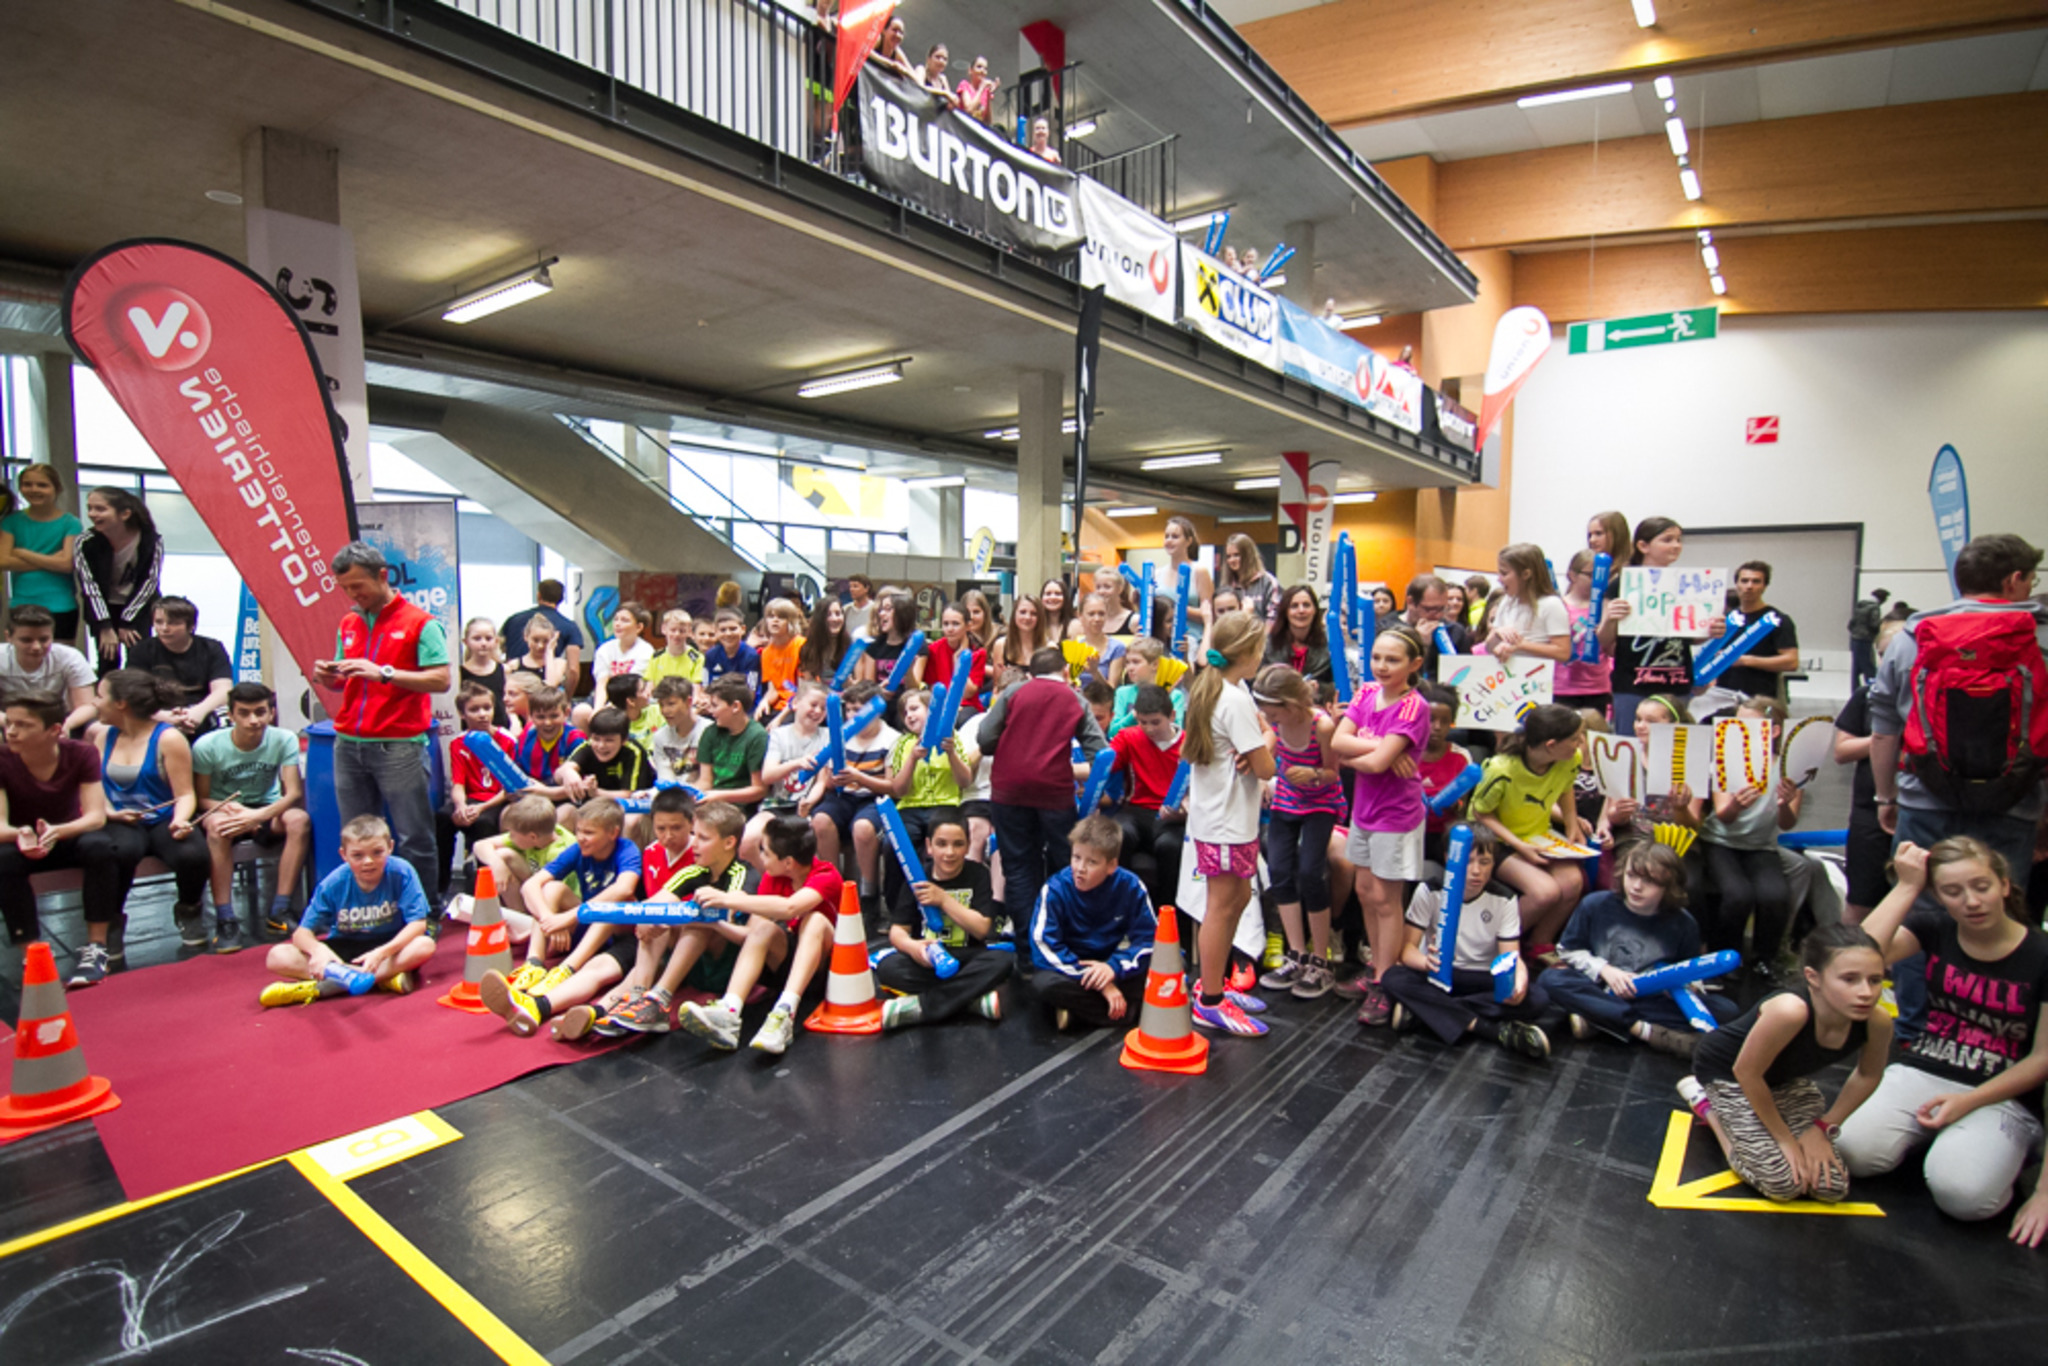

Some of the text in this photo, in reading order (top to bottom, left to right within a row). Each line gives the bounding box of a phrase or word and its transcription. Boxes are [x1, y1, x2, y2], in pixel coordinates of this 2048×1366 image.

[870, 95, 1044, 230] BURTON
[1220, 278, 1273, 342] CLUB
[1307, 516, 1325, 583] union
[1943, 963, 2031, 1014] WILL
